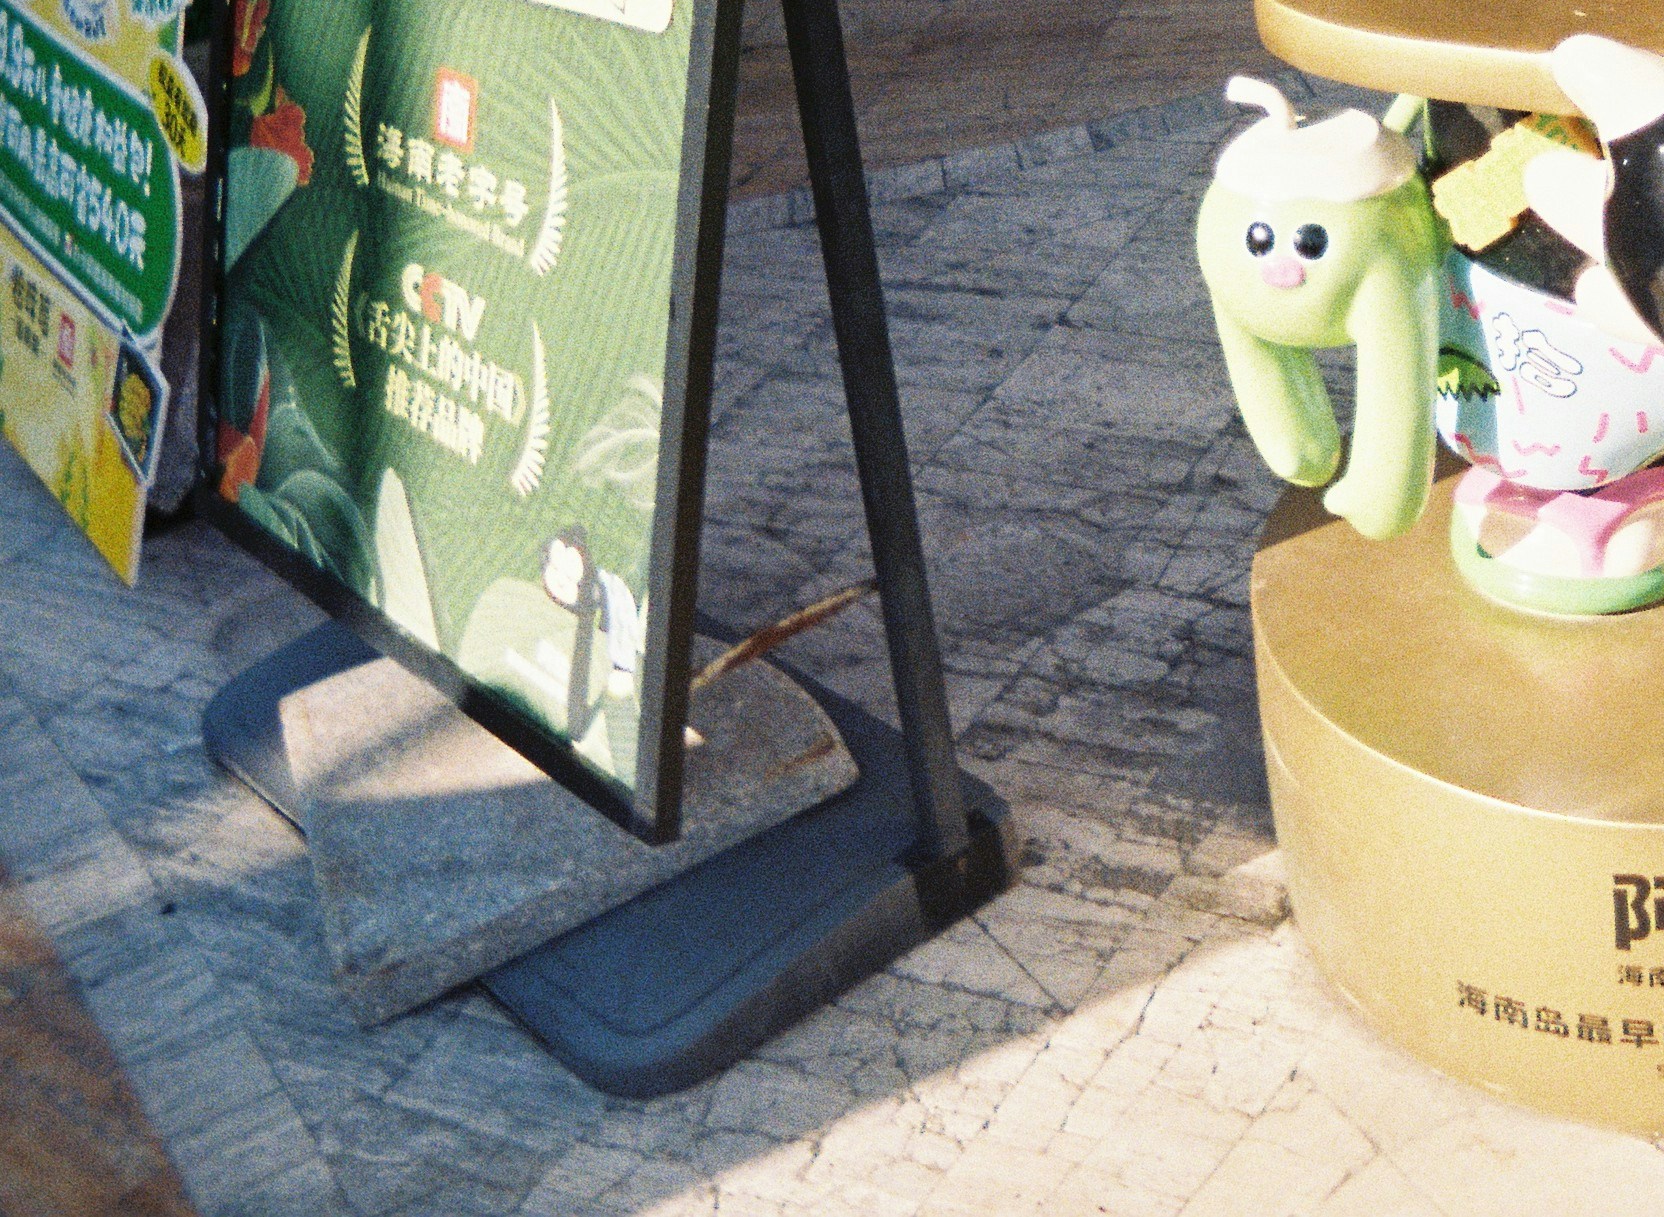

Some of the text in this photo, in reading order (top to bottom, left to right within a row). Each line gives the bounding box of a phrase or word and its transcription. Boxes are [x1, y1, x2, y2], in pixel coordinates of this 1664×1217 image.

[402, 262, 486, 342] CCTV
[385, 364, 485, 465] 推荐品牌
